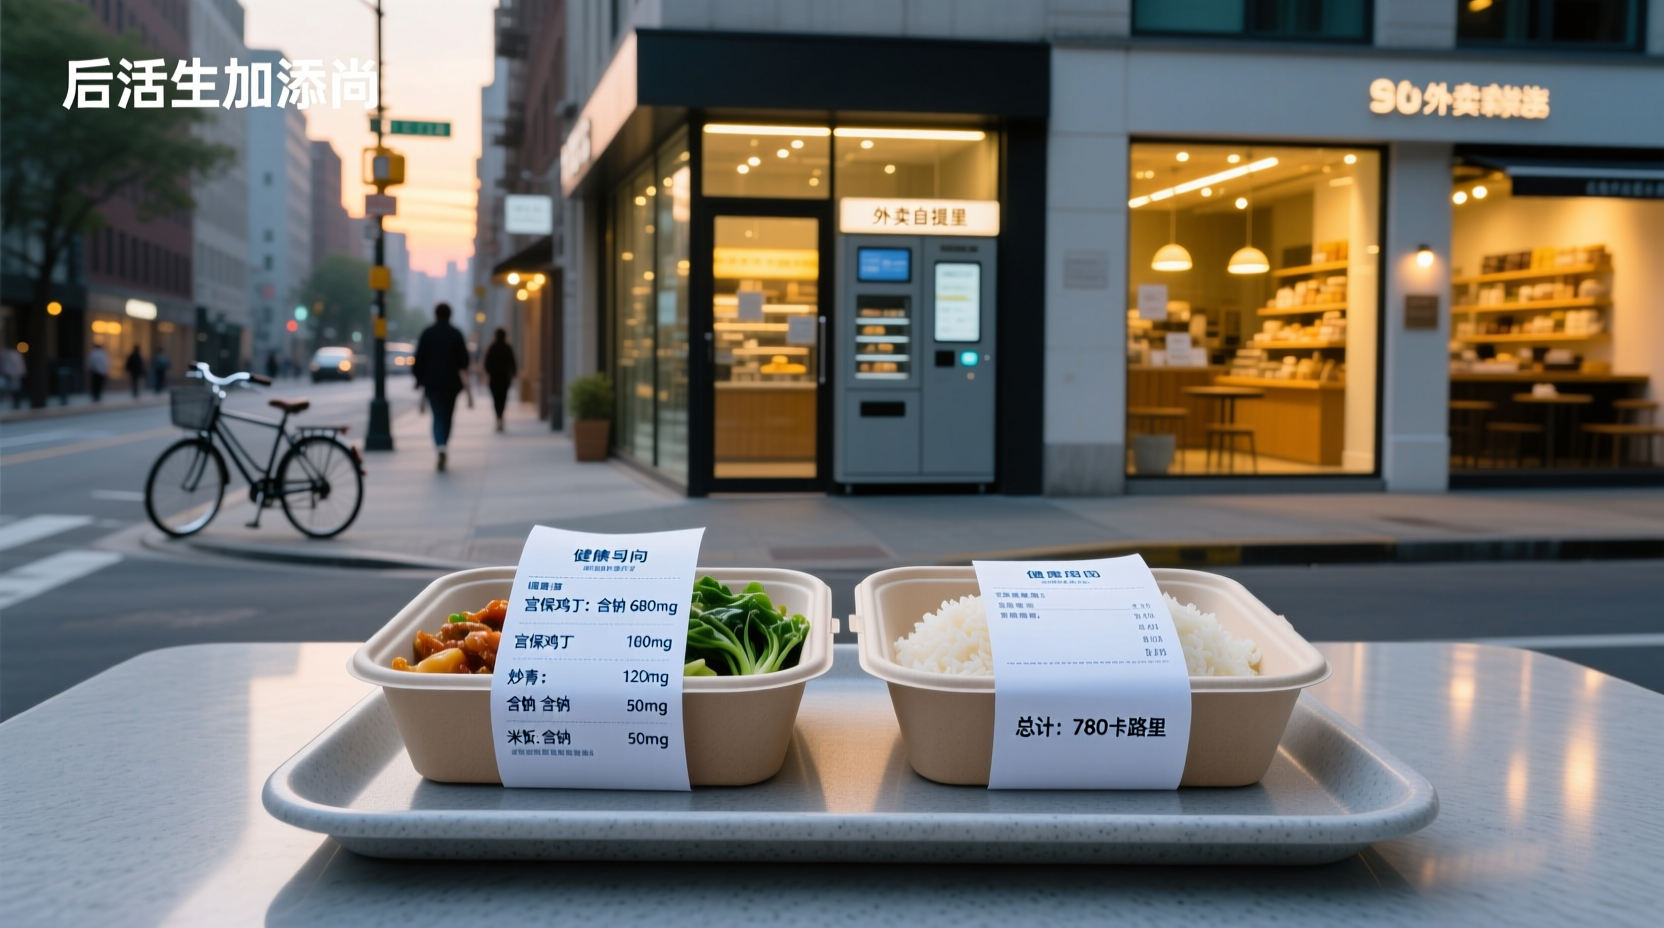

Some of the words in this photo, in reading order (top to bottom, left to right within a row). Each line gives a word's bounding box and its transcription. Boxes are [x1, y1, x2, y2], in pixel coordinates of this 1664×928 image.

[630, 599, 678, 616] 680mg
[622, 669, 669, 688] 120mg
[626, 698, 668, 717] 50mg
[1015, 716, 1167, 738] 总计：780卡路里
[628, 731, 669, 749] 50mg
